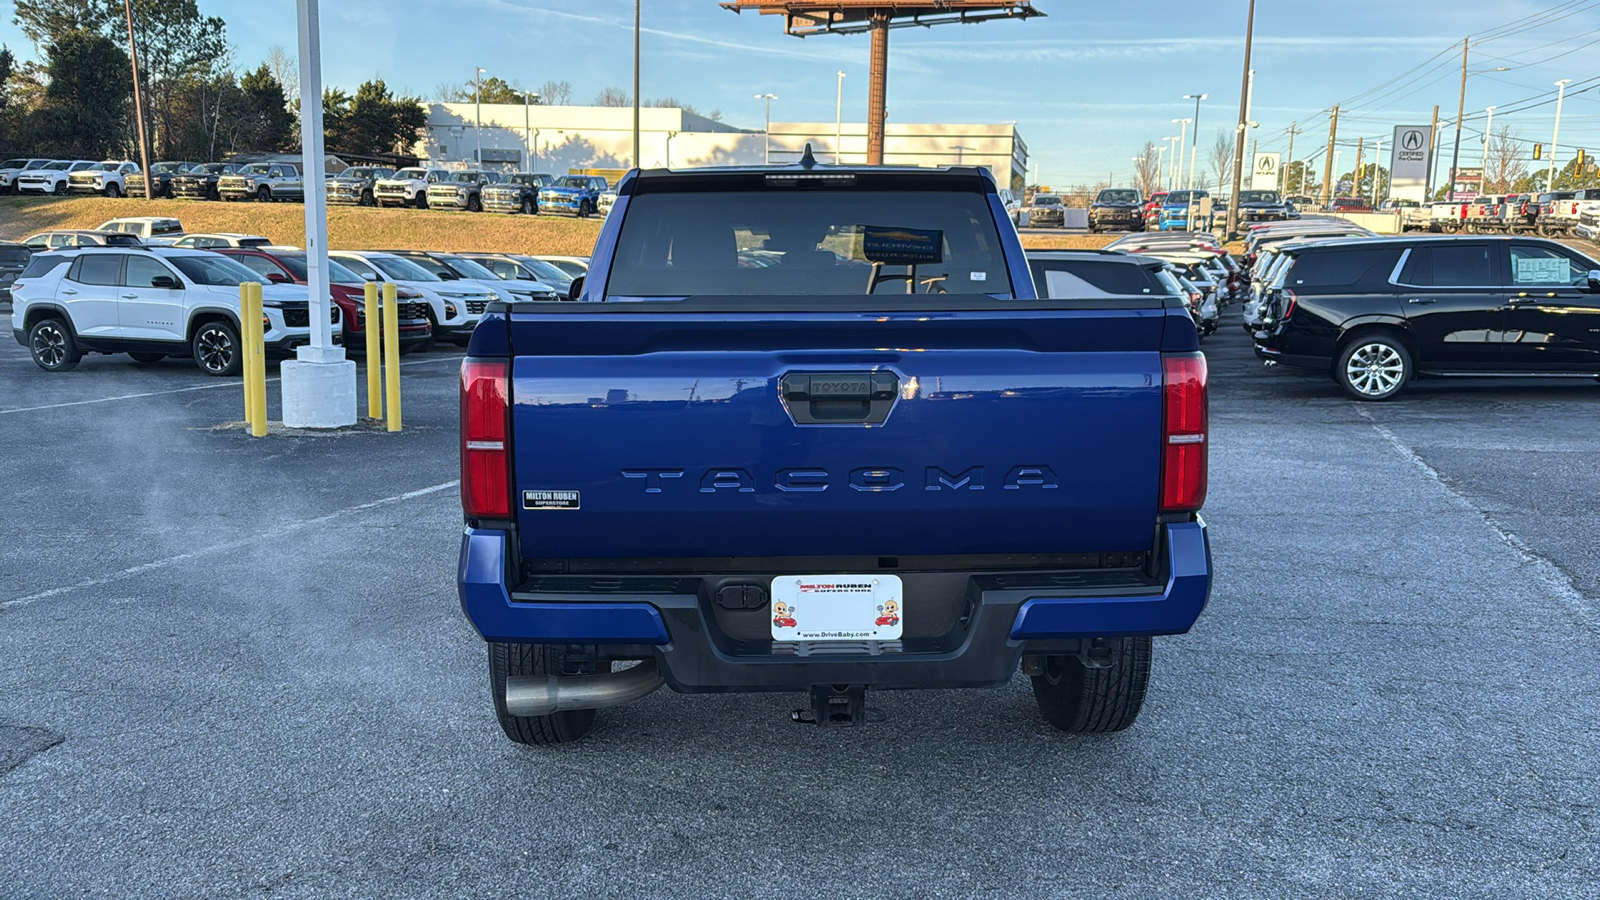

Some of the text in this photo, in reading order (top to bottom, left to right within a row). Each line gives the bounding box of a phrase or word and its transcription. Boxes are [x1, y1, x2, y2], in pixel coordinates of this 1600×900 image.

[813, 382, 868, 393] TOYOTA
[621, 464, 1058, 493] TACOMA
[526, 492, 577, 500] MILTON RUBEN
